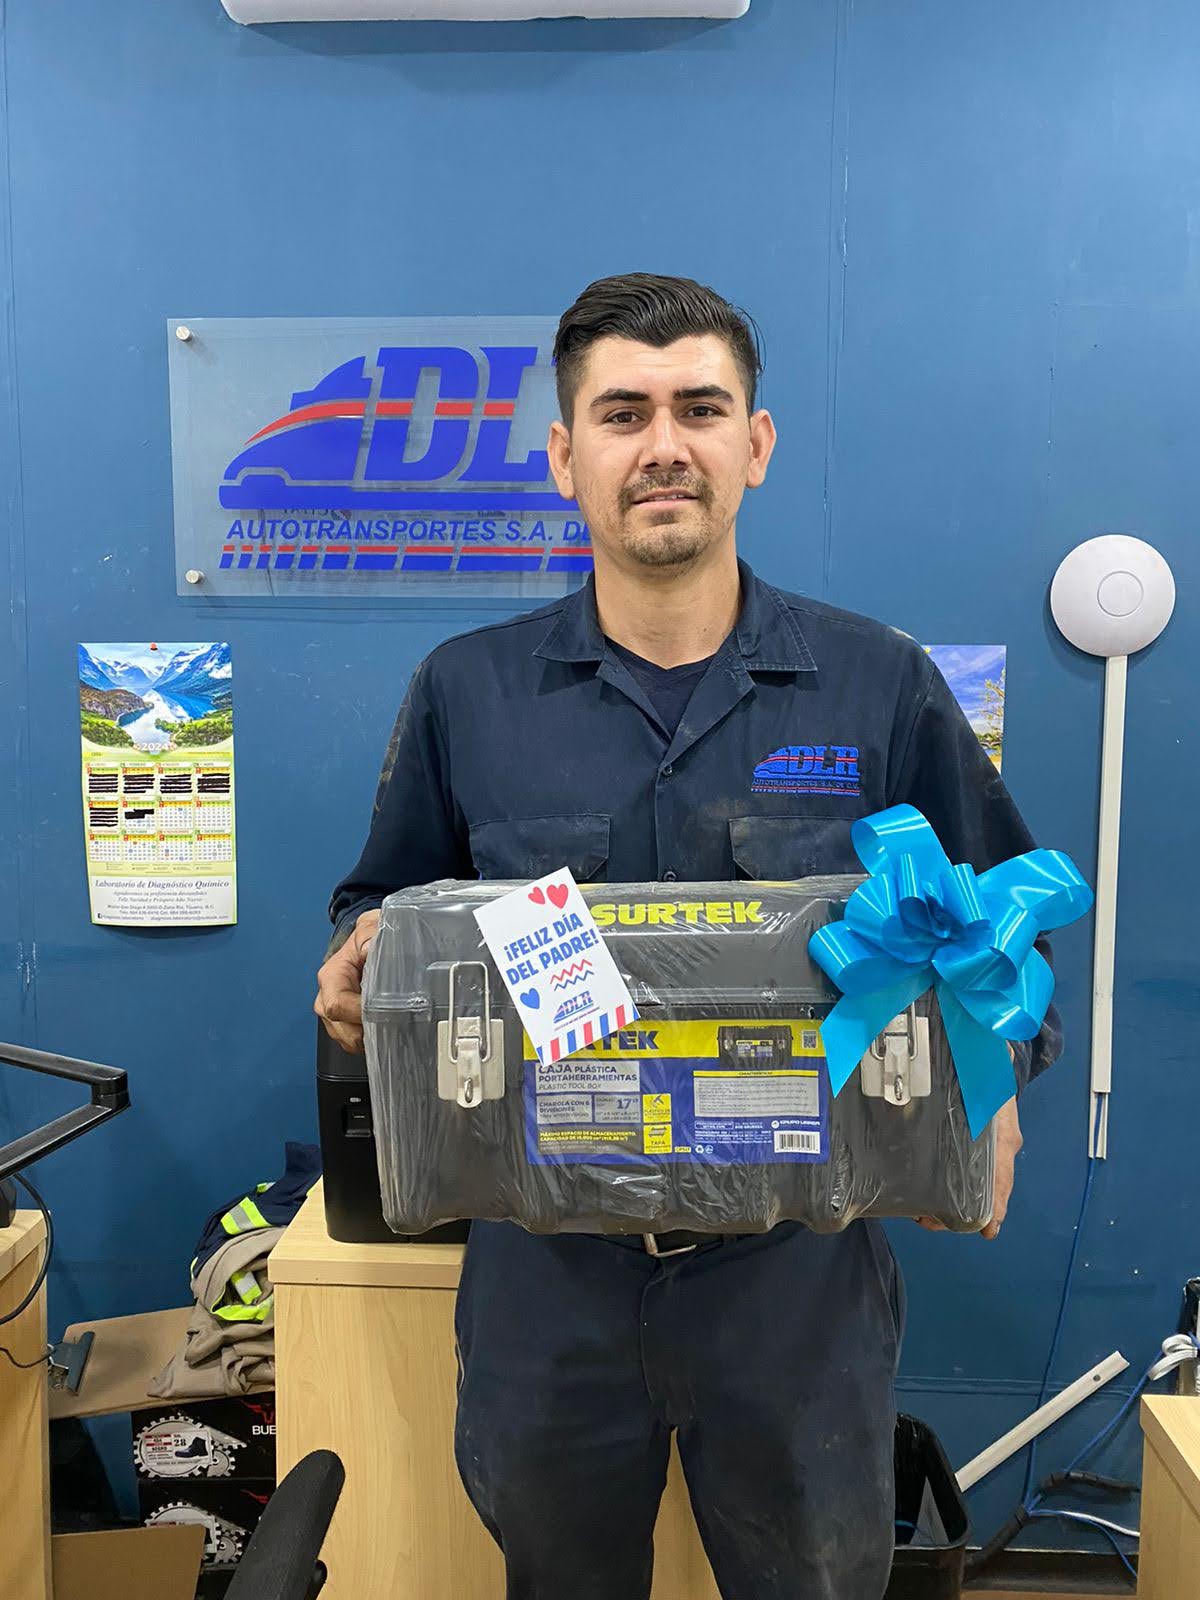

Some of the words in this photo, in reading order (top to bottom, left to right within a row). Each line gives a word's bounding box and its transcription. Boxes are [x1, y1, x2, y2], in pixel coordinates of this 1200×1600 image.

[364, 346, 557, 481] DL
[226, 519, 497, 541] AUTOTRANSPORTES
[505, 520, 553, 541] S.A.
[142, 742, 169, 752] 2024
[95, 879, 136, 888] Laboratorio
[147, 880, 193, 890] Diagnóstico
[194, 880, 230, 890] Químico
[590, 901, 765, 926] SURTEK
[504, 926, 553, 962] ¡FELIZ
[552, 912, 584, 938] DÍA
[505, 959, 539, 986] DEL
[538, 928, 599, 970] PADRE!
[584, 1030, 660, 1050] TEK
[538, 1064, 572, 1074] CAJA
[574, 1063, 617, 1073] PLÁSTICA
[538, 1073, 638, 1082] PORTAHERRAMIENTAS
[173, 1438, 187, 1447] 28
